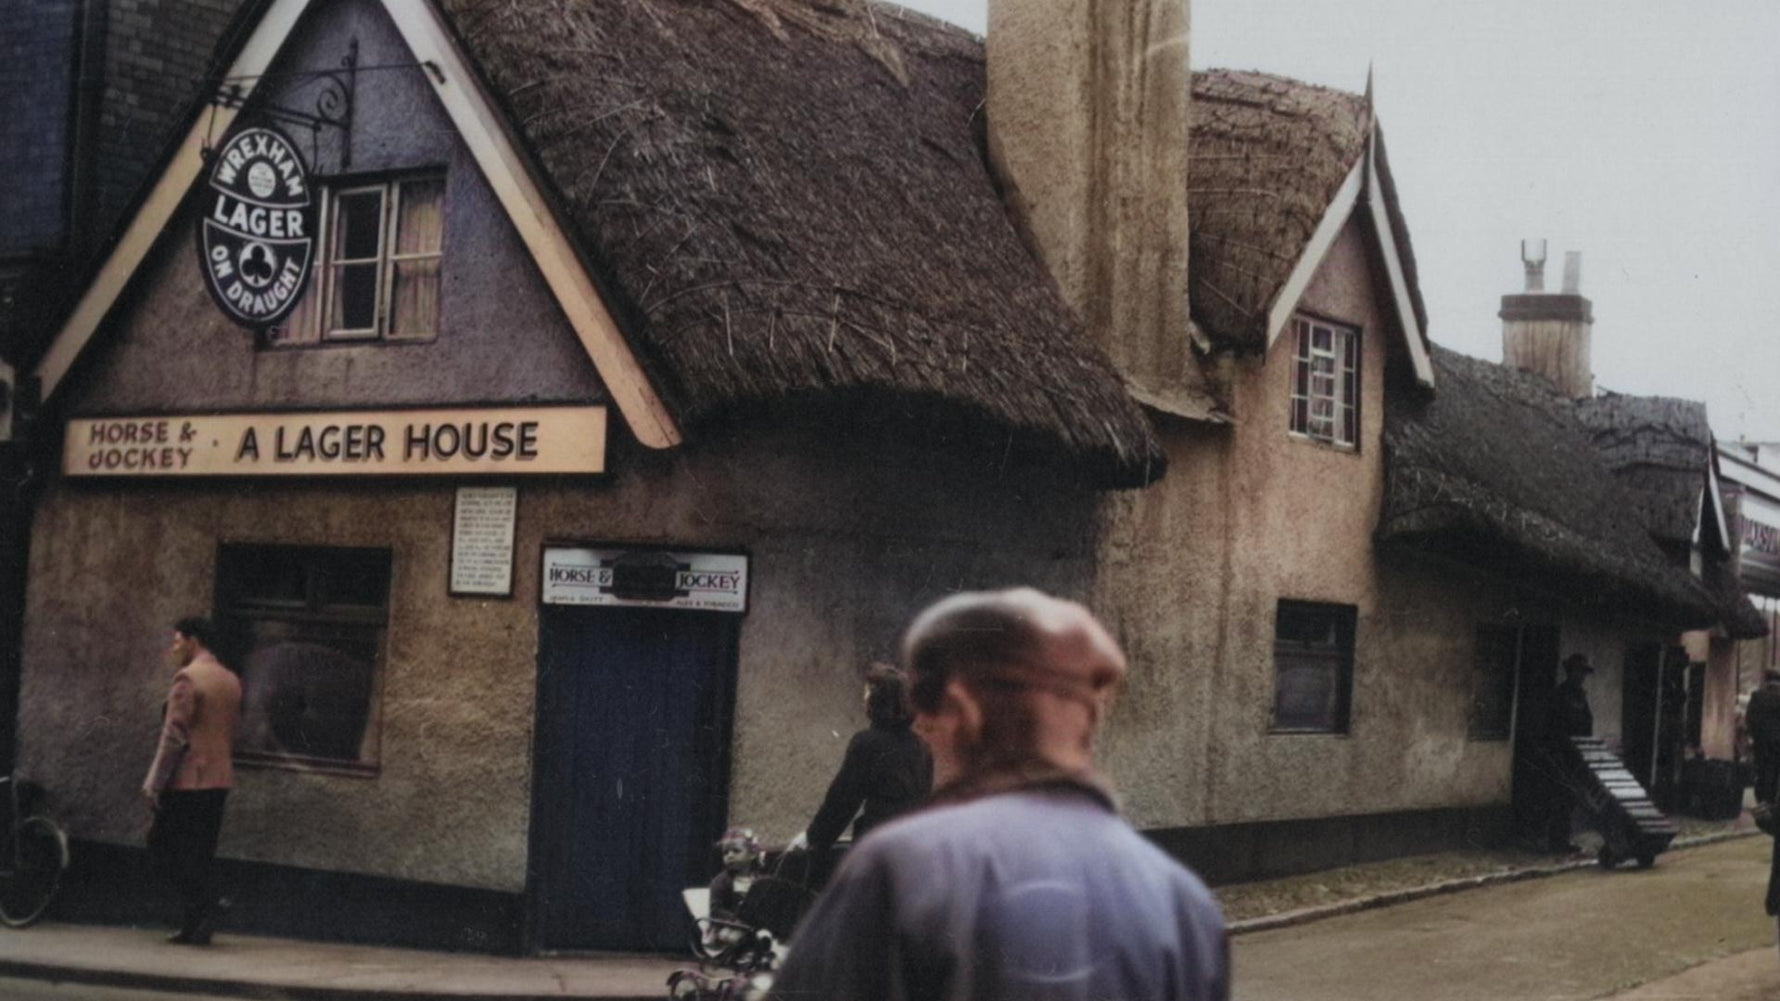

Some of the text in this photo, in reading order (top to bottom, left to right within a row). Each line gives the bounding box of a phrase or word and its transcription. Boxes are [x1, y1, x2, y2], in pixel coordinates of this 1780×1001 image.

[217, 134, 303, 197] WREXHAM
[214, 195, 304, 237] LAGER
[211, 245, 300, 314] ON DRAUGHT
[90, 421, 197, 446] HORSE &
[235, 421, 539, 463] A LAGER HOUSE
[88, 447, 193, 471] JOCKEY
[549, 567, 741, 590] HORSE & JOCKEY
